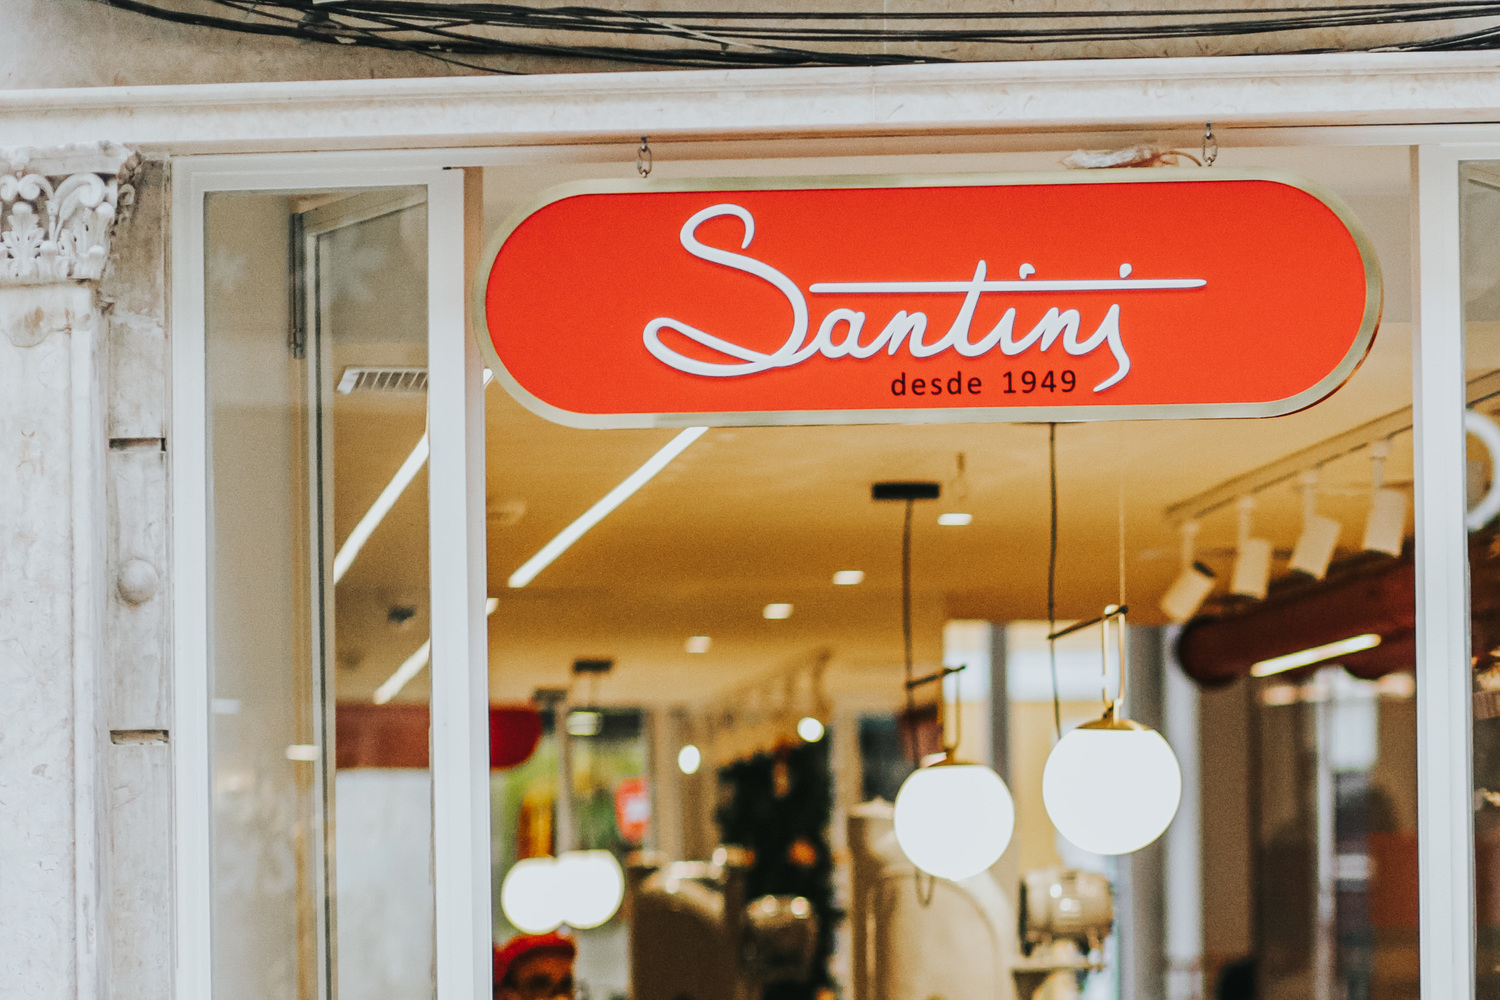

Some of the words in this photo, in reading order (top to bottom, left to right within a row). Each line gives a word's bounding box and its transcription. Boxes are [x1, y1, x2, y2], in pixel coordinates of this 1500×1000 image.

[642, 203, 1208, 393] Santini
[891, 371, 982, 396] desde
[1003, 370, 1076, 395] 1949
